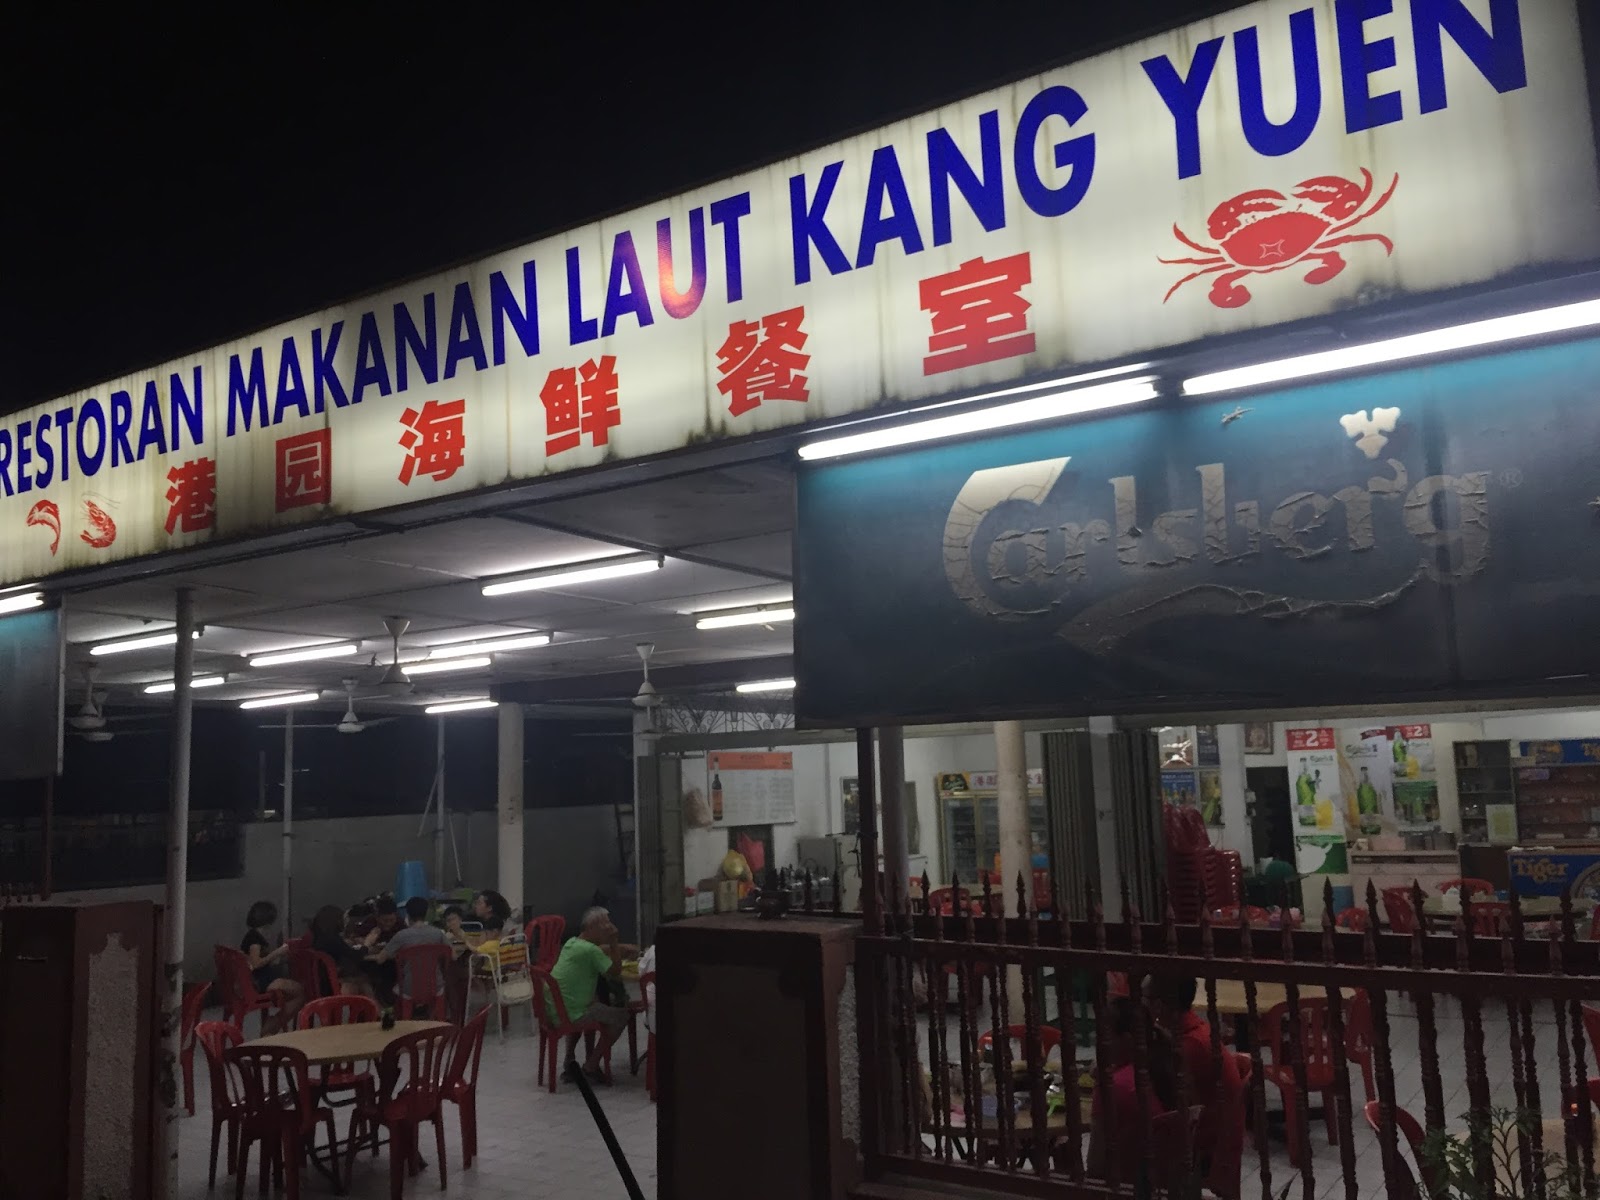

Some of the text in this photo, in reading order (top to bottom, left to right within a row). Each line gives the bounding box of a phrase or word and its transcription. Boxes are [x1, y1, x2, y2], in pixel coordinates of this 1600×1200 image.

[0, 0, 1527, 497] RESTORAN MAKANAN LAUT KANG YUEN
[163, 251, 1037, 536] 港园海鲜餐室
[942, 455, 1493, 623] Carlsberg
[1305, 729, 1319, 747] 2
[1512, 857, 1570, 884] Tiger
